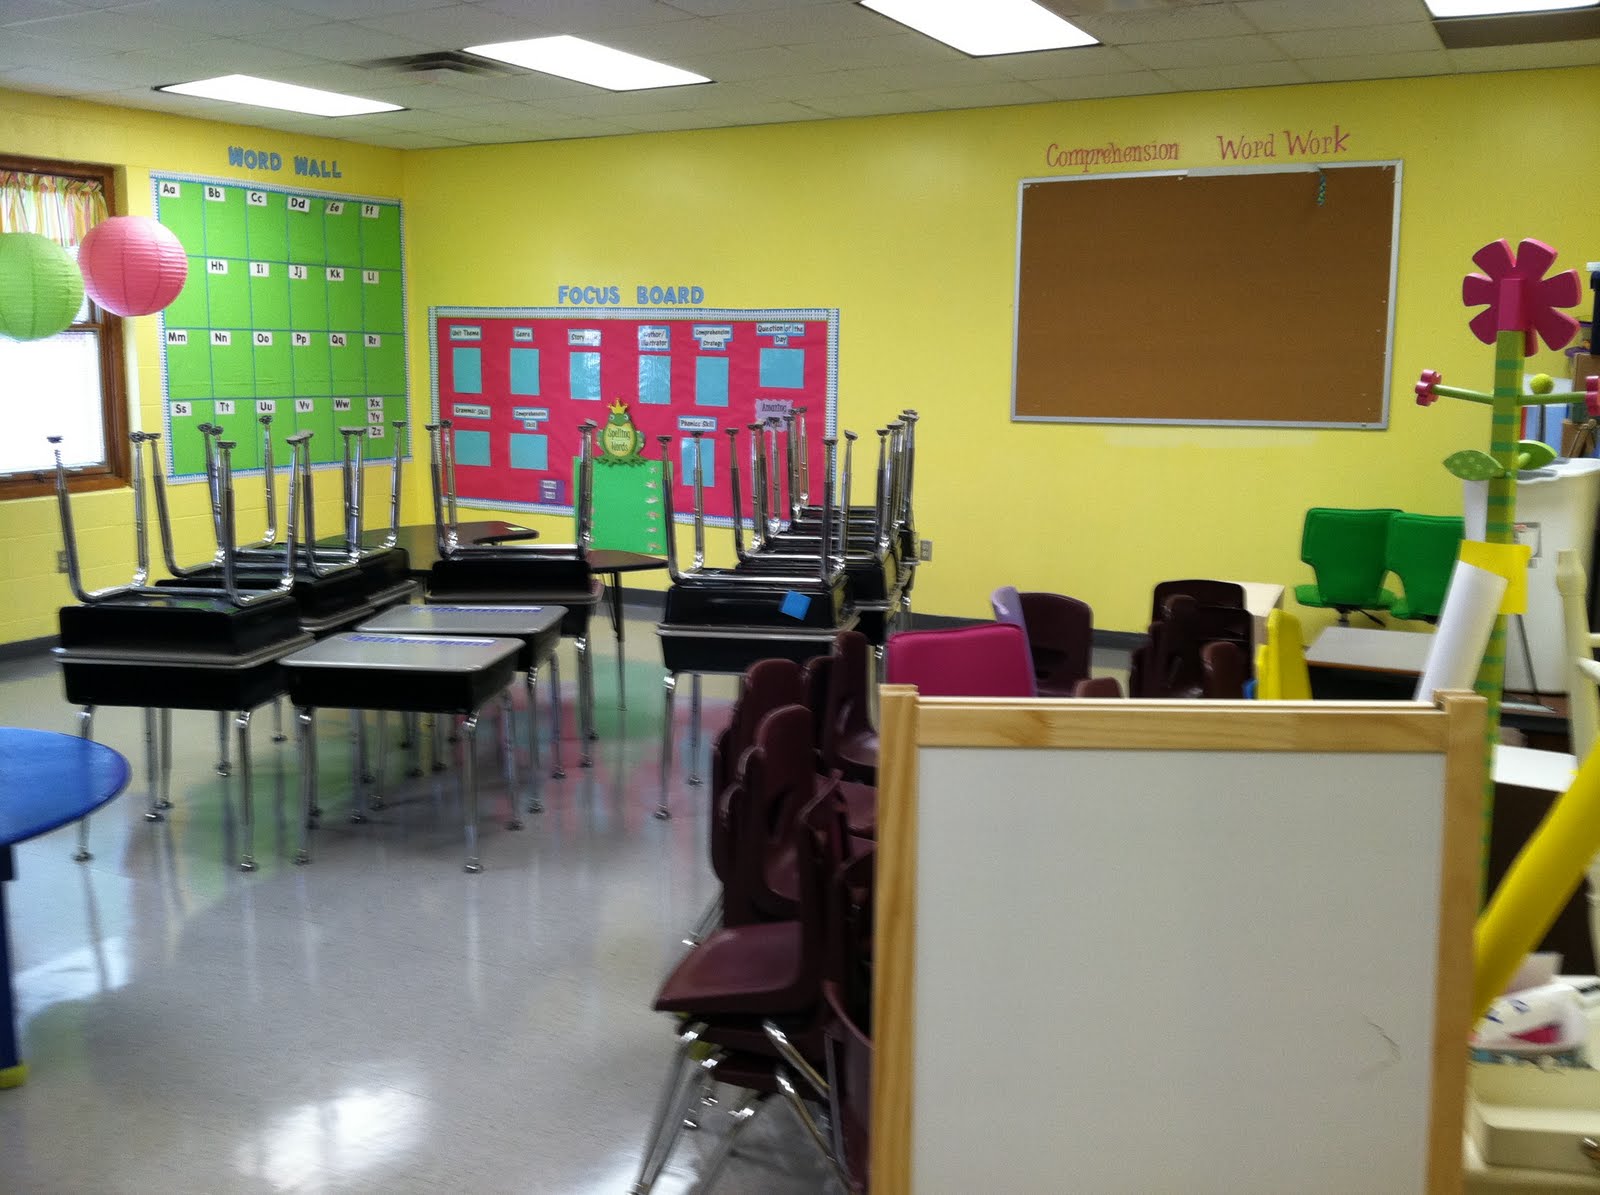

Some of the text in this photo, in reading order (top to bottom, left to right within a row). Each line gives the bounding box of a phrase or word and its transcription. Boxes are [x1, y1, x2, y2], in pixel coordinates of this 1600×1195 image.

[1217, 125, 1350, 160] Word Work
[1046, 141, 1180, 172] Comprehension
[228, 146, 342, 178] WORD WALL
[163, 184, 176, 194] Aa
[208, 188, 221, 198] Bb
[251, 192, 263, 203] Cc
[291, 197, 306, 210] Dd
[330, 202, 340, 213] Ee
[365, 205, 375, 216] Ff
[211, 260, 224, 272] Hh
[294, 264, 302, 279] Jj
[330, 268, 341, 280] Kk
[558, 286, 704, 304] FOCUS BOARD
[758, 324, 783, 334] Question
[168, 332, 186, 342] Mm
[214, 333, 228, 343] Nn
[257, 334, 270, 344] Oo
[296, 334, 307, 346] Pp
[332, 334, 344, 346] Qq
[368, 335, 378, 345] Rr
[572, 334, 584, 342] Story
[776, 336, 787, 344] Day
[220, 402, 230, 412] Tt
[260, 402, 273, 412] Uu
[300, 400, 310, 410] Vv
[335, 399, 350, 409] Ww
[370, 398, 380, 408] Xx
[175, 404, 187, 414] Ss
[371, 412, 381, 423] Yy
[680, 419, 714, 428] Phonics Skill
[372, 427, 382, 436] Zz
[608, 428, 630, 440] Spelling
[612, 441, 629, 451] Words
